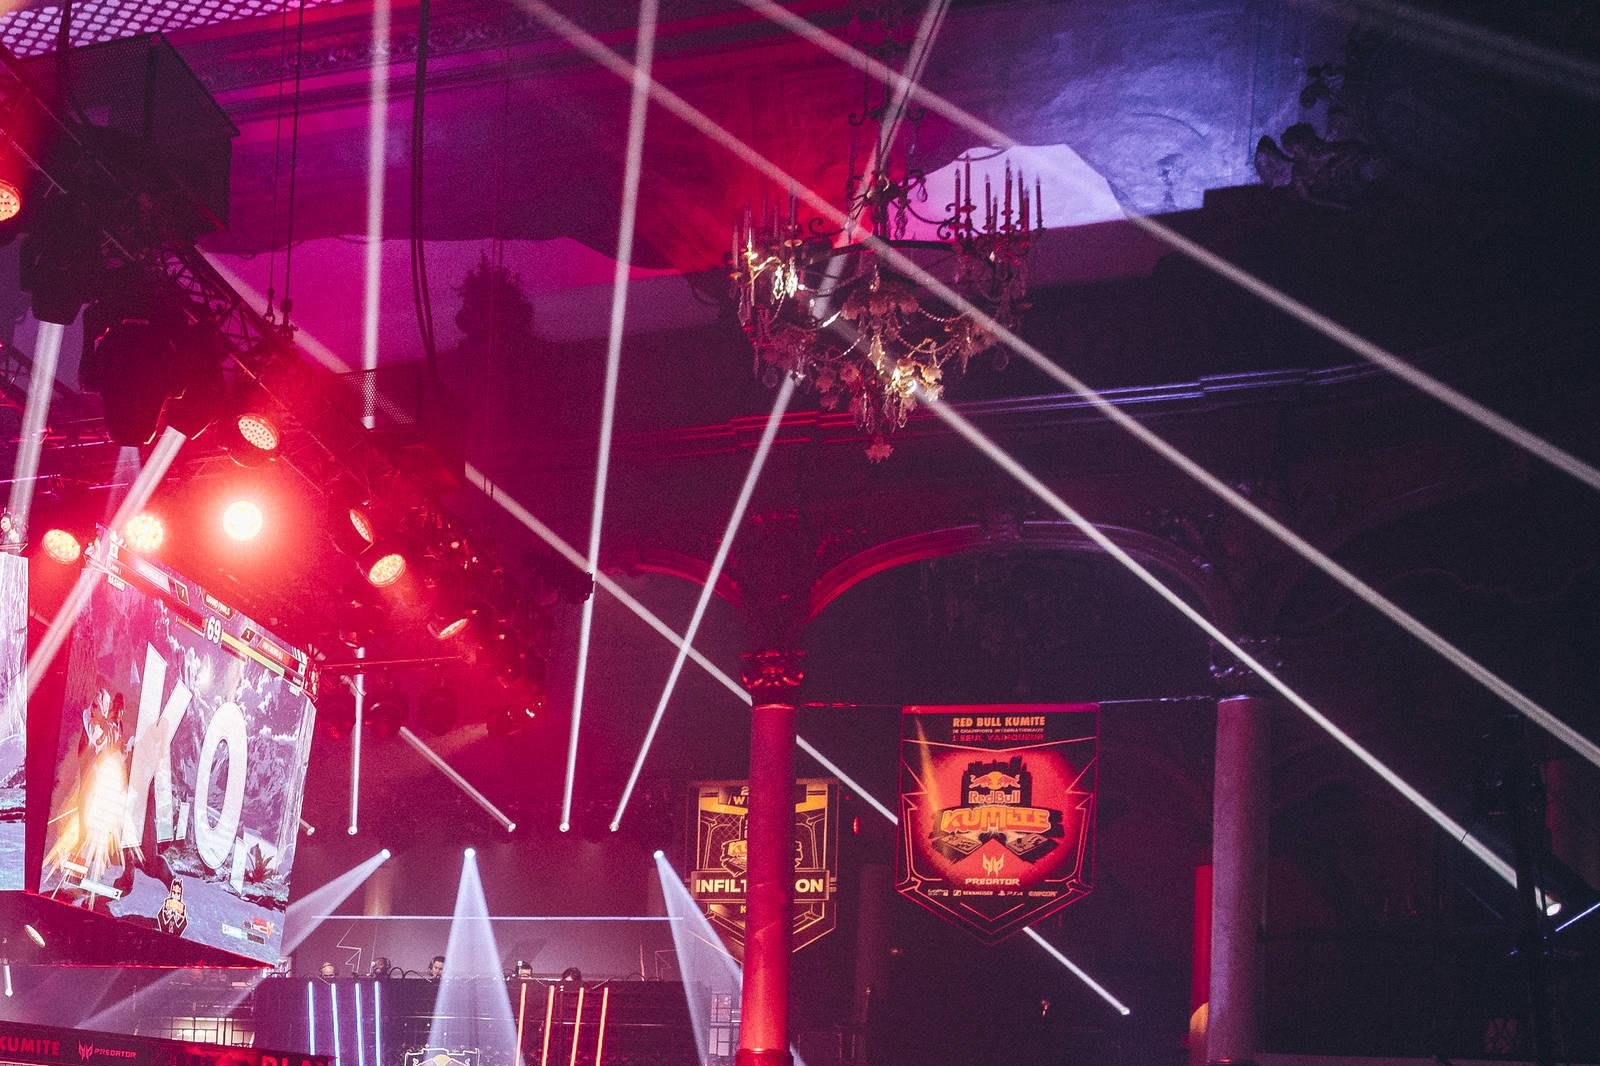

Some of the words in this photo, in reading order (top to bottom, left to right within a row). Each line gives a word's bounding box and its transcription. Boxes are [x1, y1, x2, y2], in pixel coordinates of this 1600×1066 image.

[207, 616, 221, 644] 69
[952, 717, 973, 727] RED
[976, 717, 1002, 727] BULL
[1005, 716, 1046, 726] KUMITE
[121, 641, 248, 896] K.O.
[968, 790, 994, 804] Red
[995, 789, 1021, 804] Bull
[695, 878, 824, 893] INFILTON
[964, 878, 1020, 886] PREDATOR
[94, 1047, 137, 1059] PREDATOR
